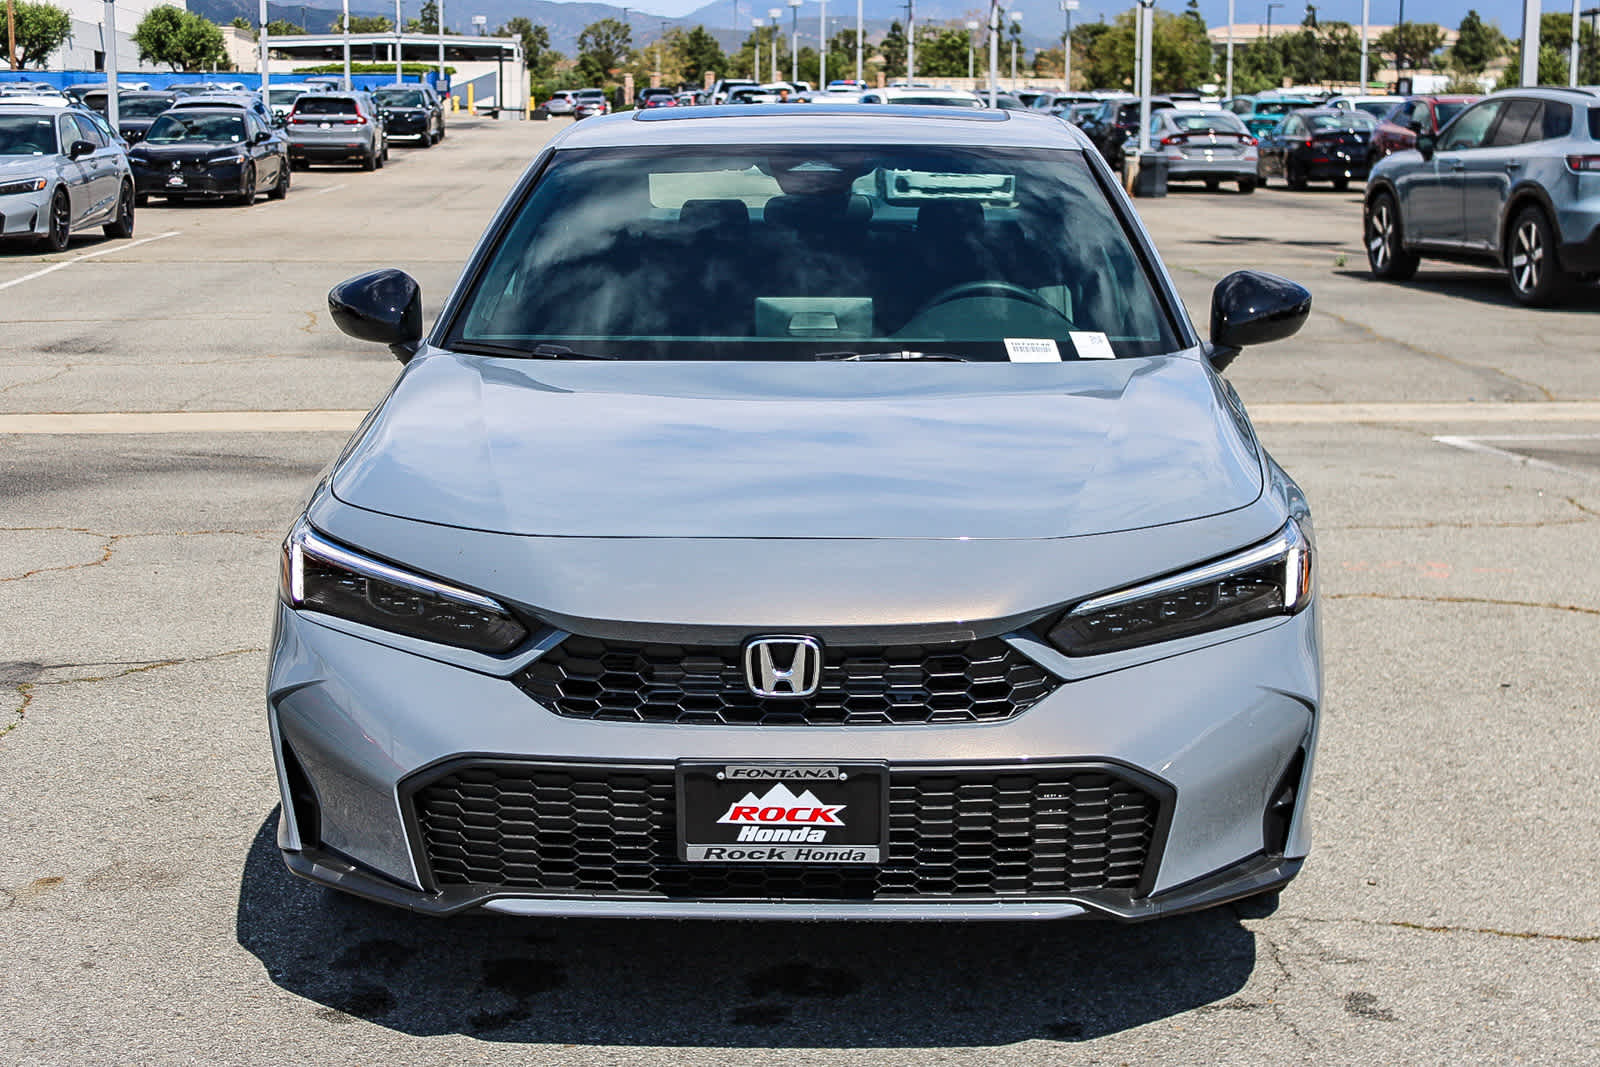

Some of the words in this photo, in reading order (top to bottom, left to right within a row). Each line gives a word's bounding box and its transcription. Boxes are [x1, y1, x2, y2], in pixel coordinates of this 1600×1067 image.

[732, 769, 835, 778] FONTANA
[729, 806, 837, 823] ROCK
[737, 826, 827, 842] Honda
[703, 848, 787, 861] Rock
[794, 849, 866, 861] Honda
